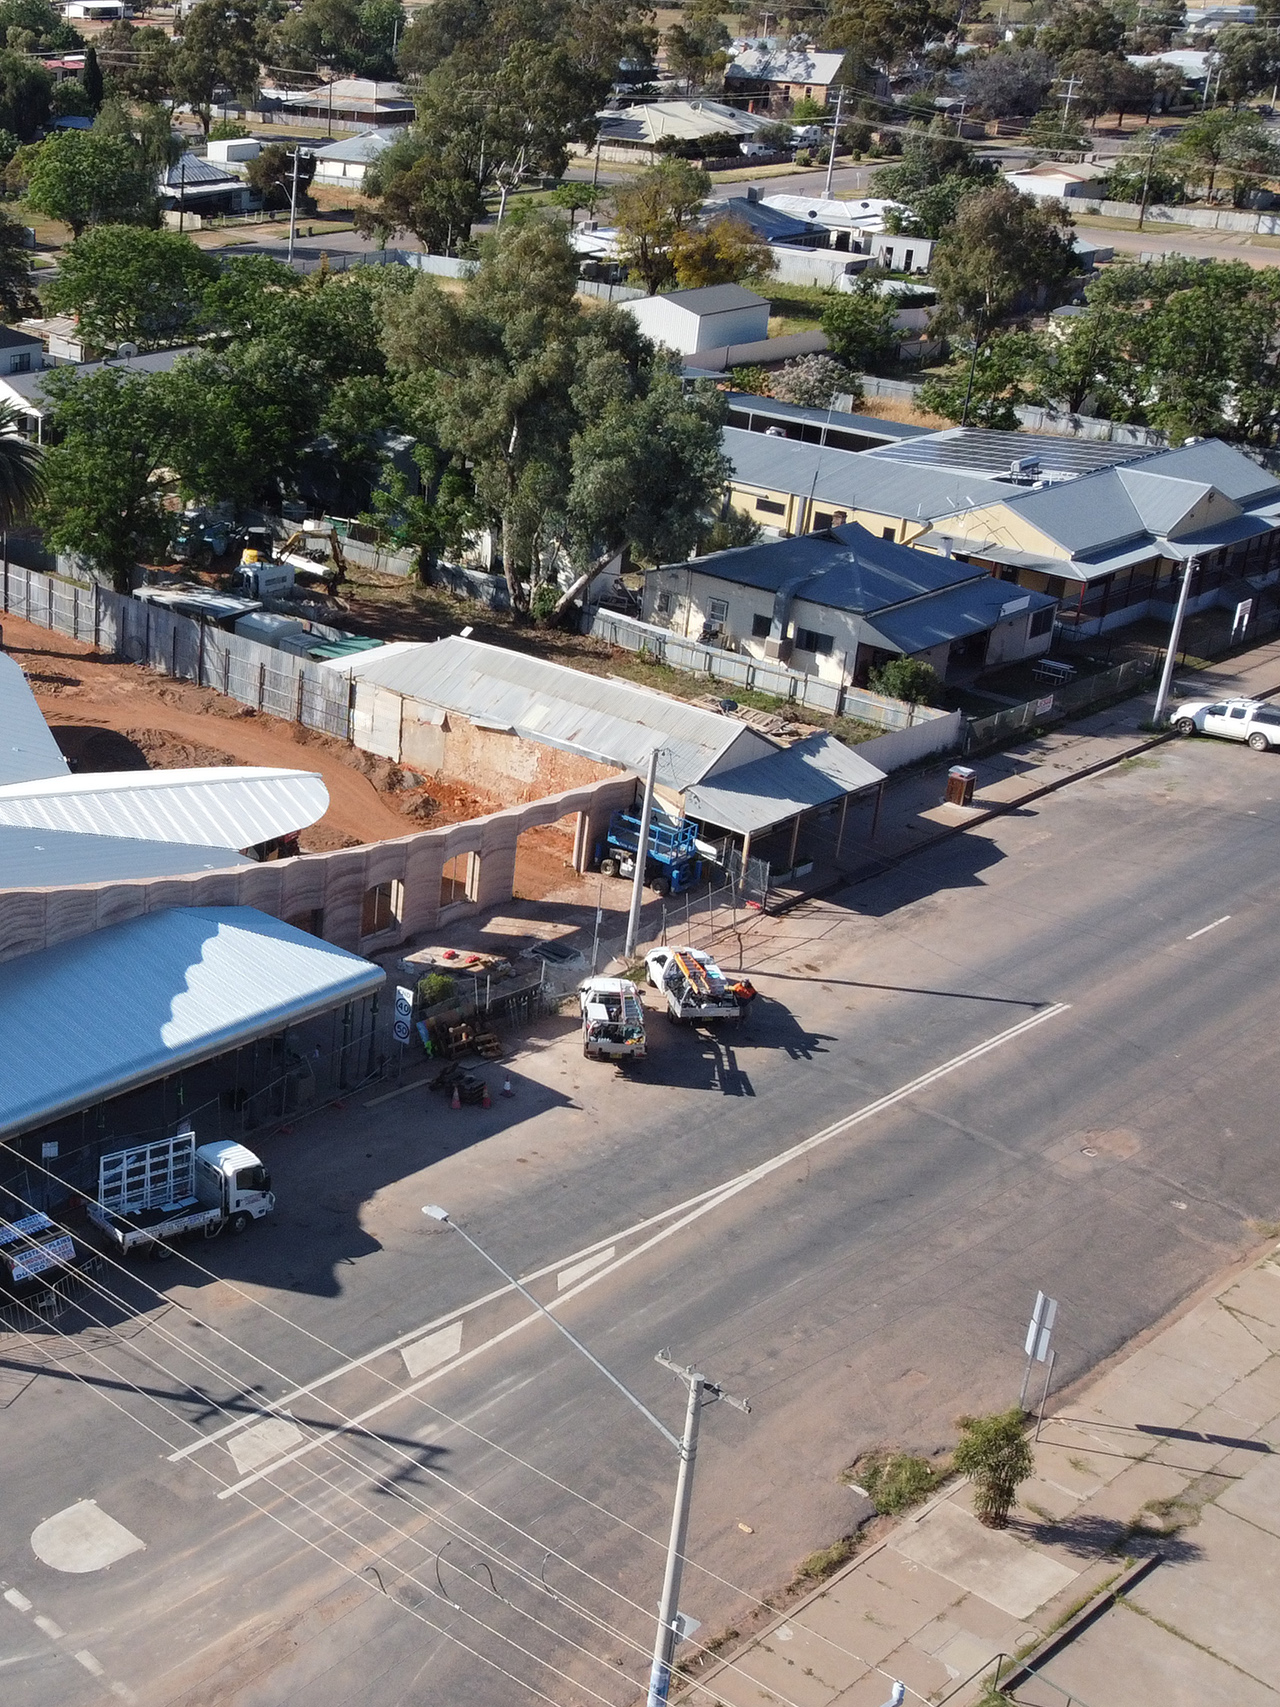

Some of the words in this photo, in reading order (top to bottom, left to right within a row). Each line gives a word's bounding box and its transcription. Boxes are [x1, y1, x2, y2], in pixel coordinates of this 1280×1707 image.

[398, 1002, 409, 1013] 40
[397, 1024, 407, 1035] 50
[18, 1245, 48, 1262] WESTE
[48, 1236, 71, 1250] PLAINS
